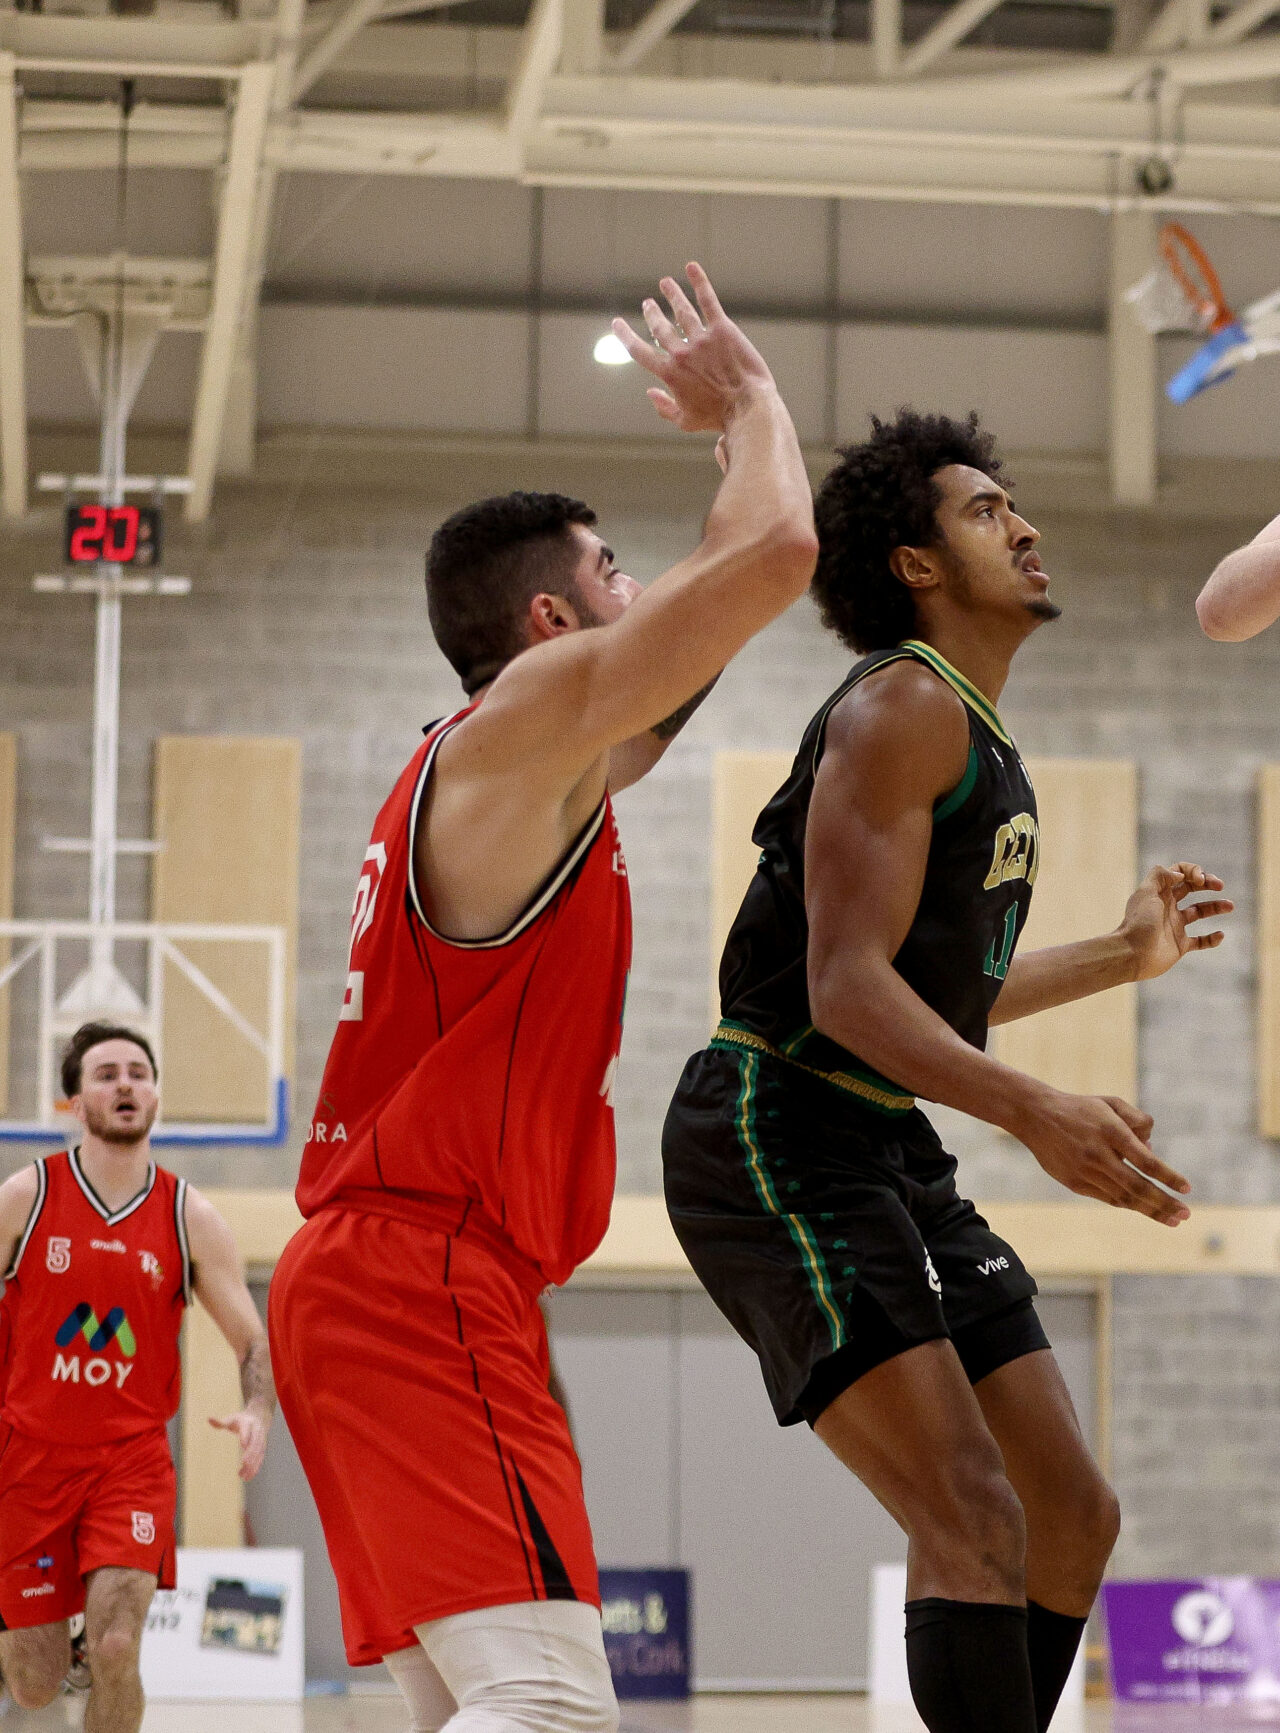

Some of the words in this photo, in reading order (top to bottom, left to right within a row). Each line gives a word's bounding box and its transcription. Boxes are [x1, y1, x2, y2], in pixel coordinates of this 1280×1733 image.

[69, 505, 140, 562] 20
[46, 1236, 71, 1274] 5
[977, 1256, 1010, 1275] vive
[52, 1353, 134, 1389] MOY
[131, 1511, 155, 1545] 5
